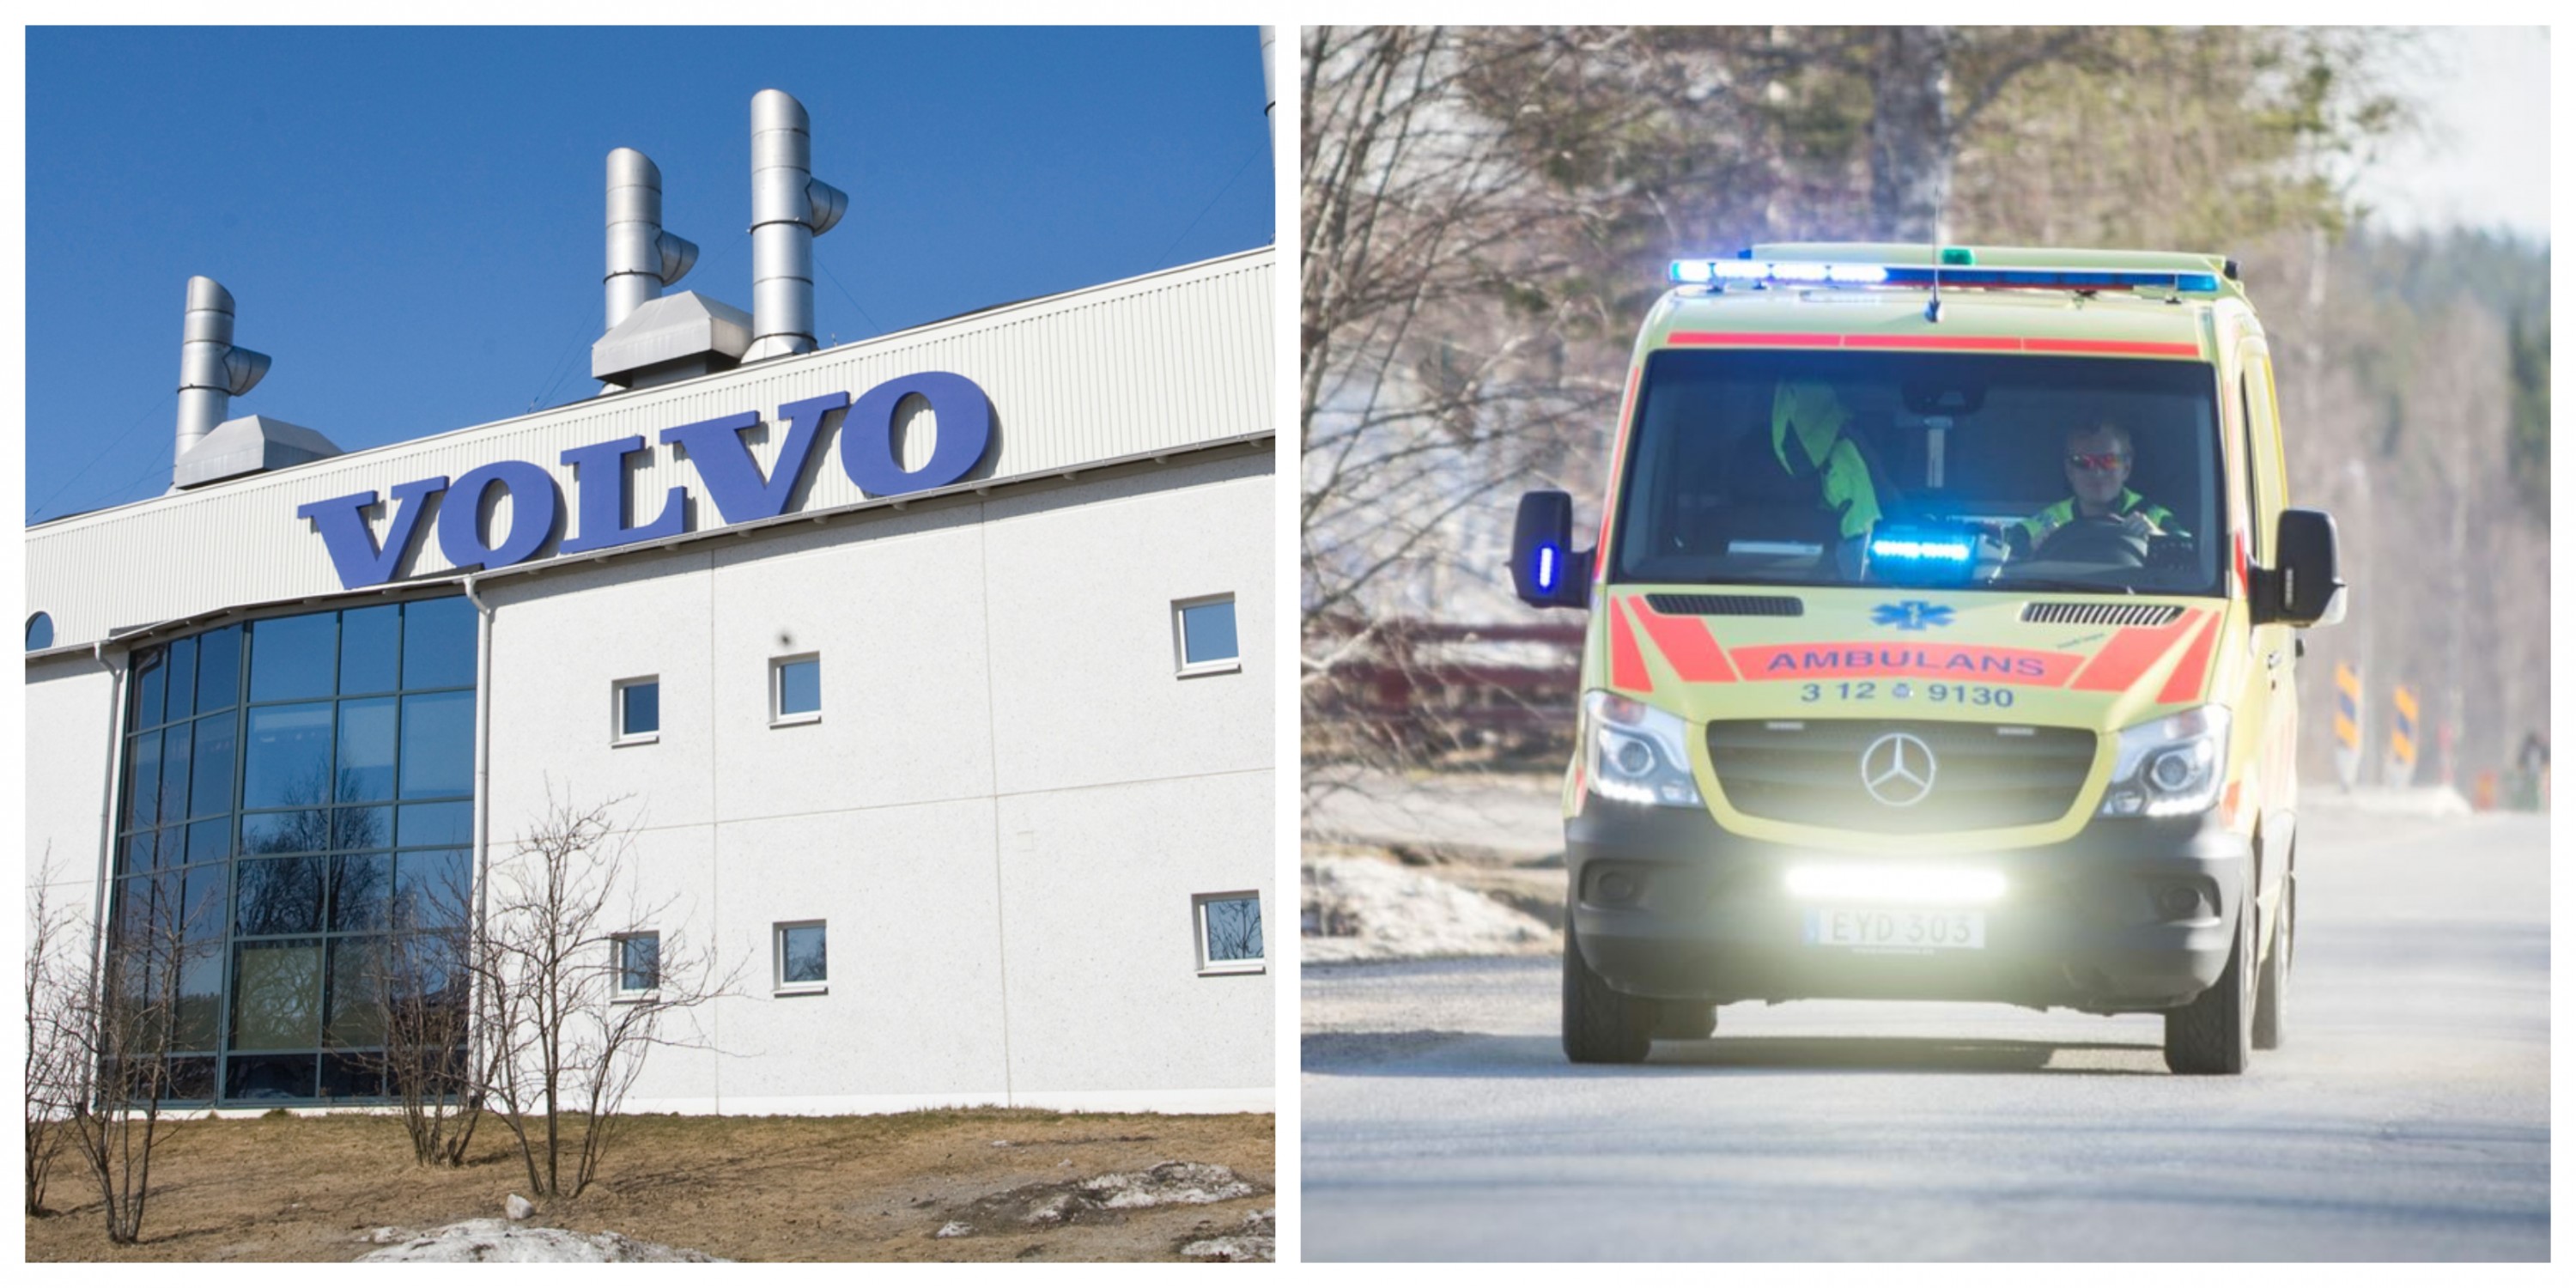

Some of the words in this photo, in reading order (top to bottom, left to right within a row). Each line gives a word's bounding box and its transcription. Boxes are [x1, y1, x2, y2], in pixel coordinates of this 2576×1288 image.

[297, 370, 997, 590] VOLVO
[1767, 650, 2045, 676] AMBULANS
[1801, 683, 1821, 702] 3
[1838, 683, 1876, 701] 12
[1929, 683, 2014, 708] 9130
[1832, 912, 1894, 942] EYD
[1905, 914, 1971, 944] 303
